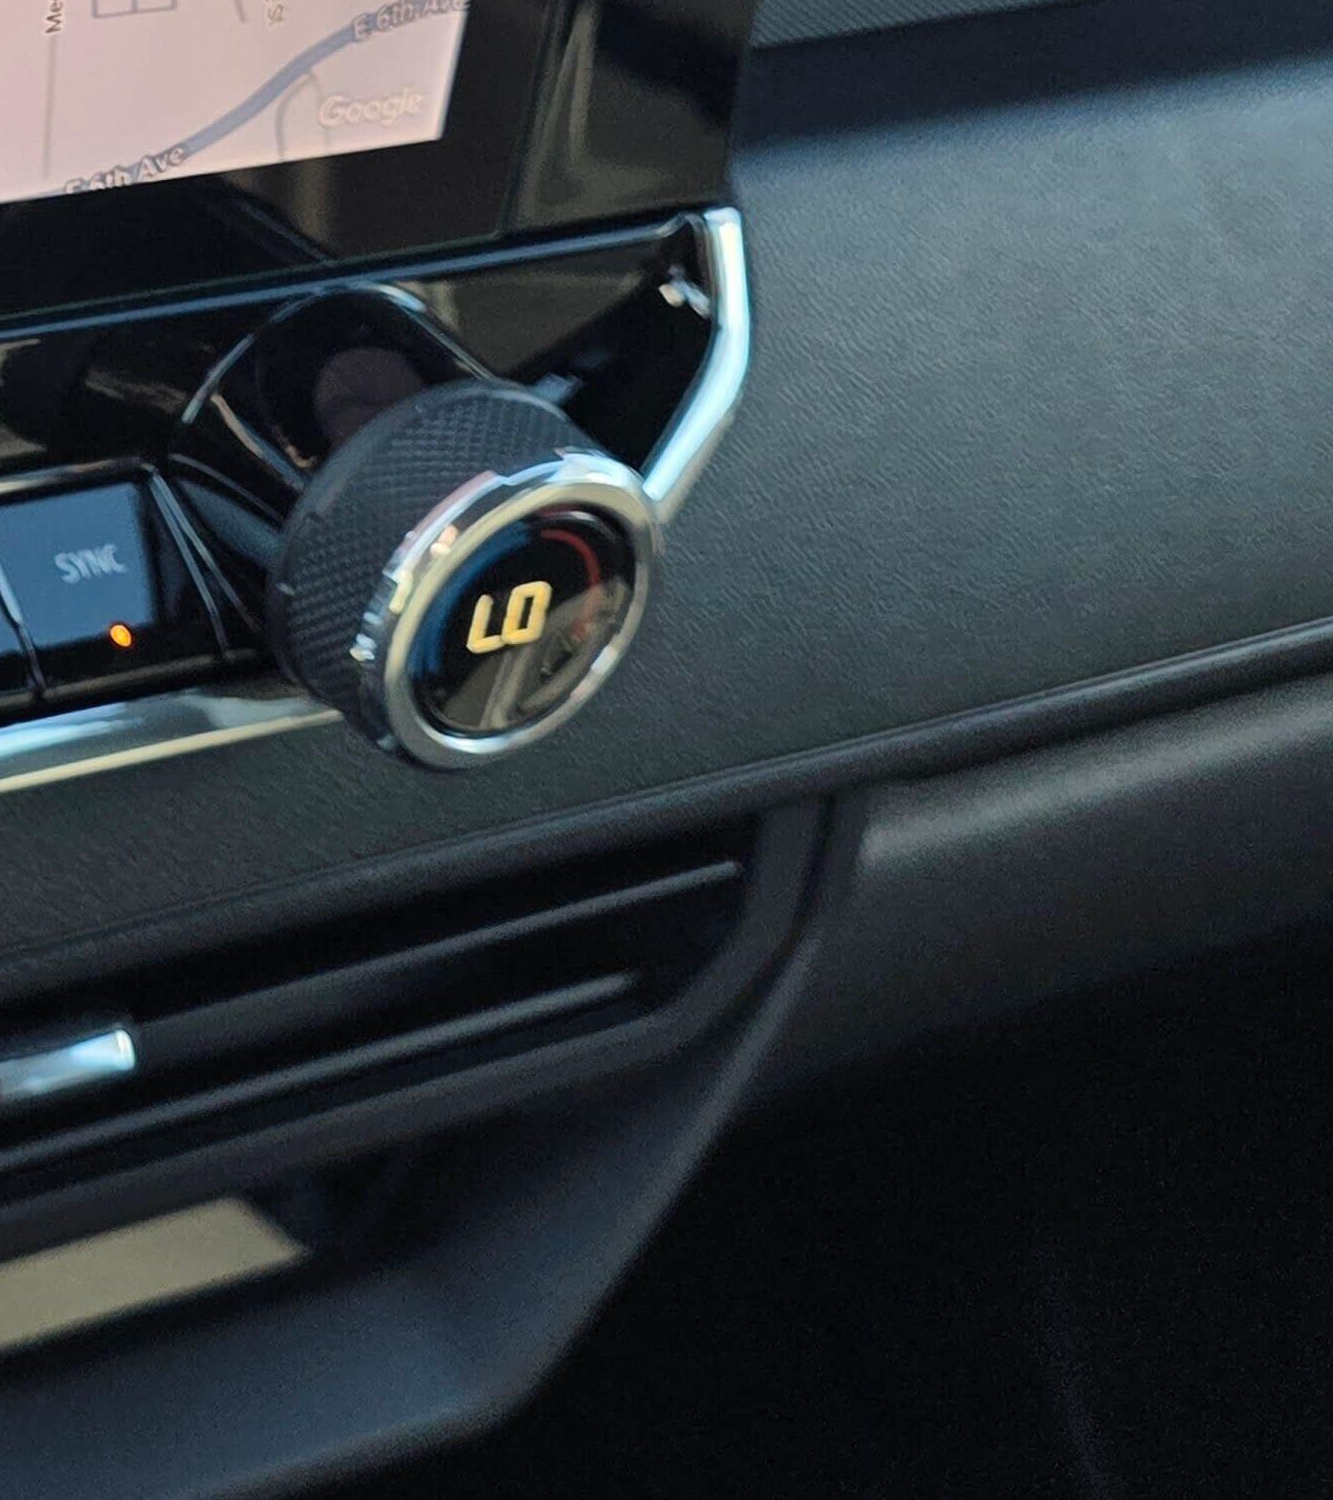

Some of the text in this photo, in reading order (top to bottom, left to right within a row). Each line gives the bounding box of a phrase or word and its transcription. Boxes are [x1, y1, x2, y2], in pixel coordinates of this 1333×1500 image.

[353, 13, 371, 41] E
[317, 85, 424, 128] Google
[137, 147, 184, 182] Ave
[53, 542, 129, 585] SYNC
